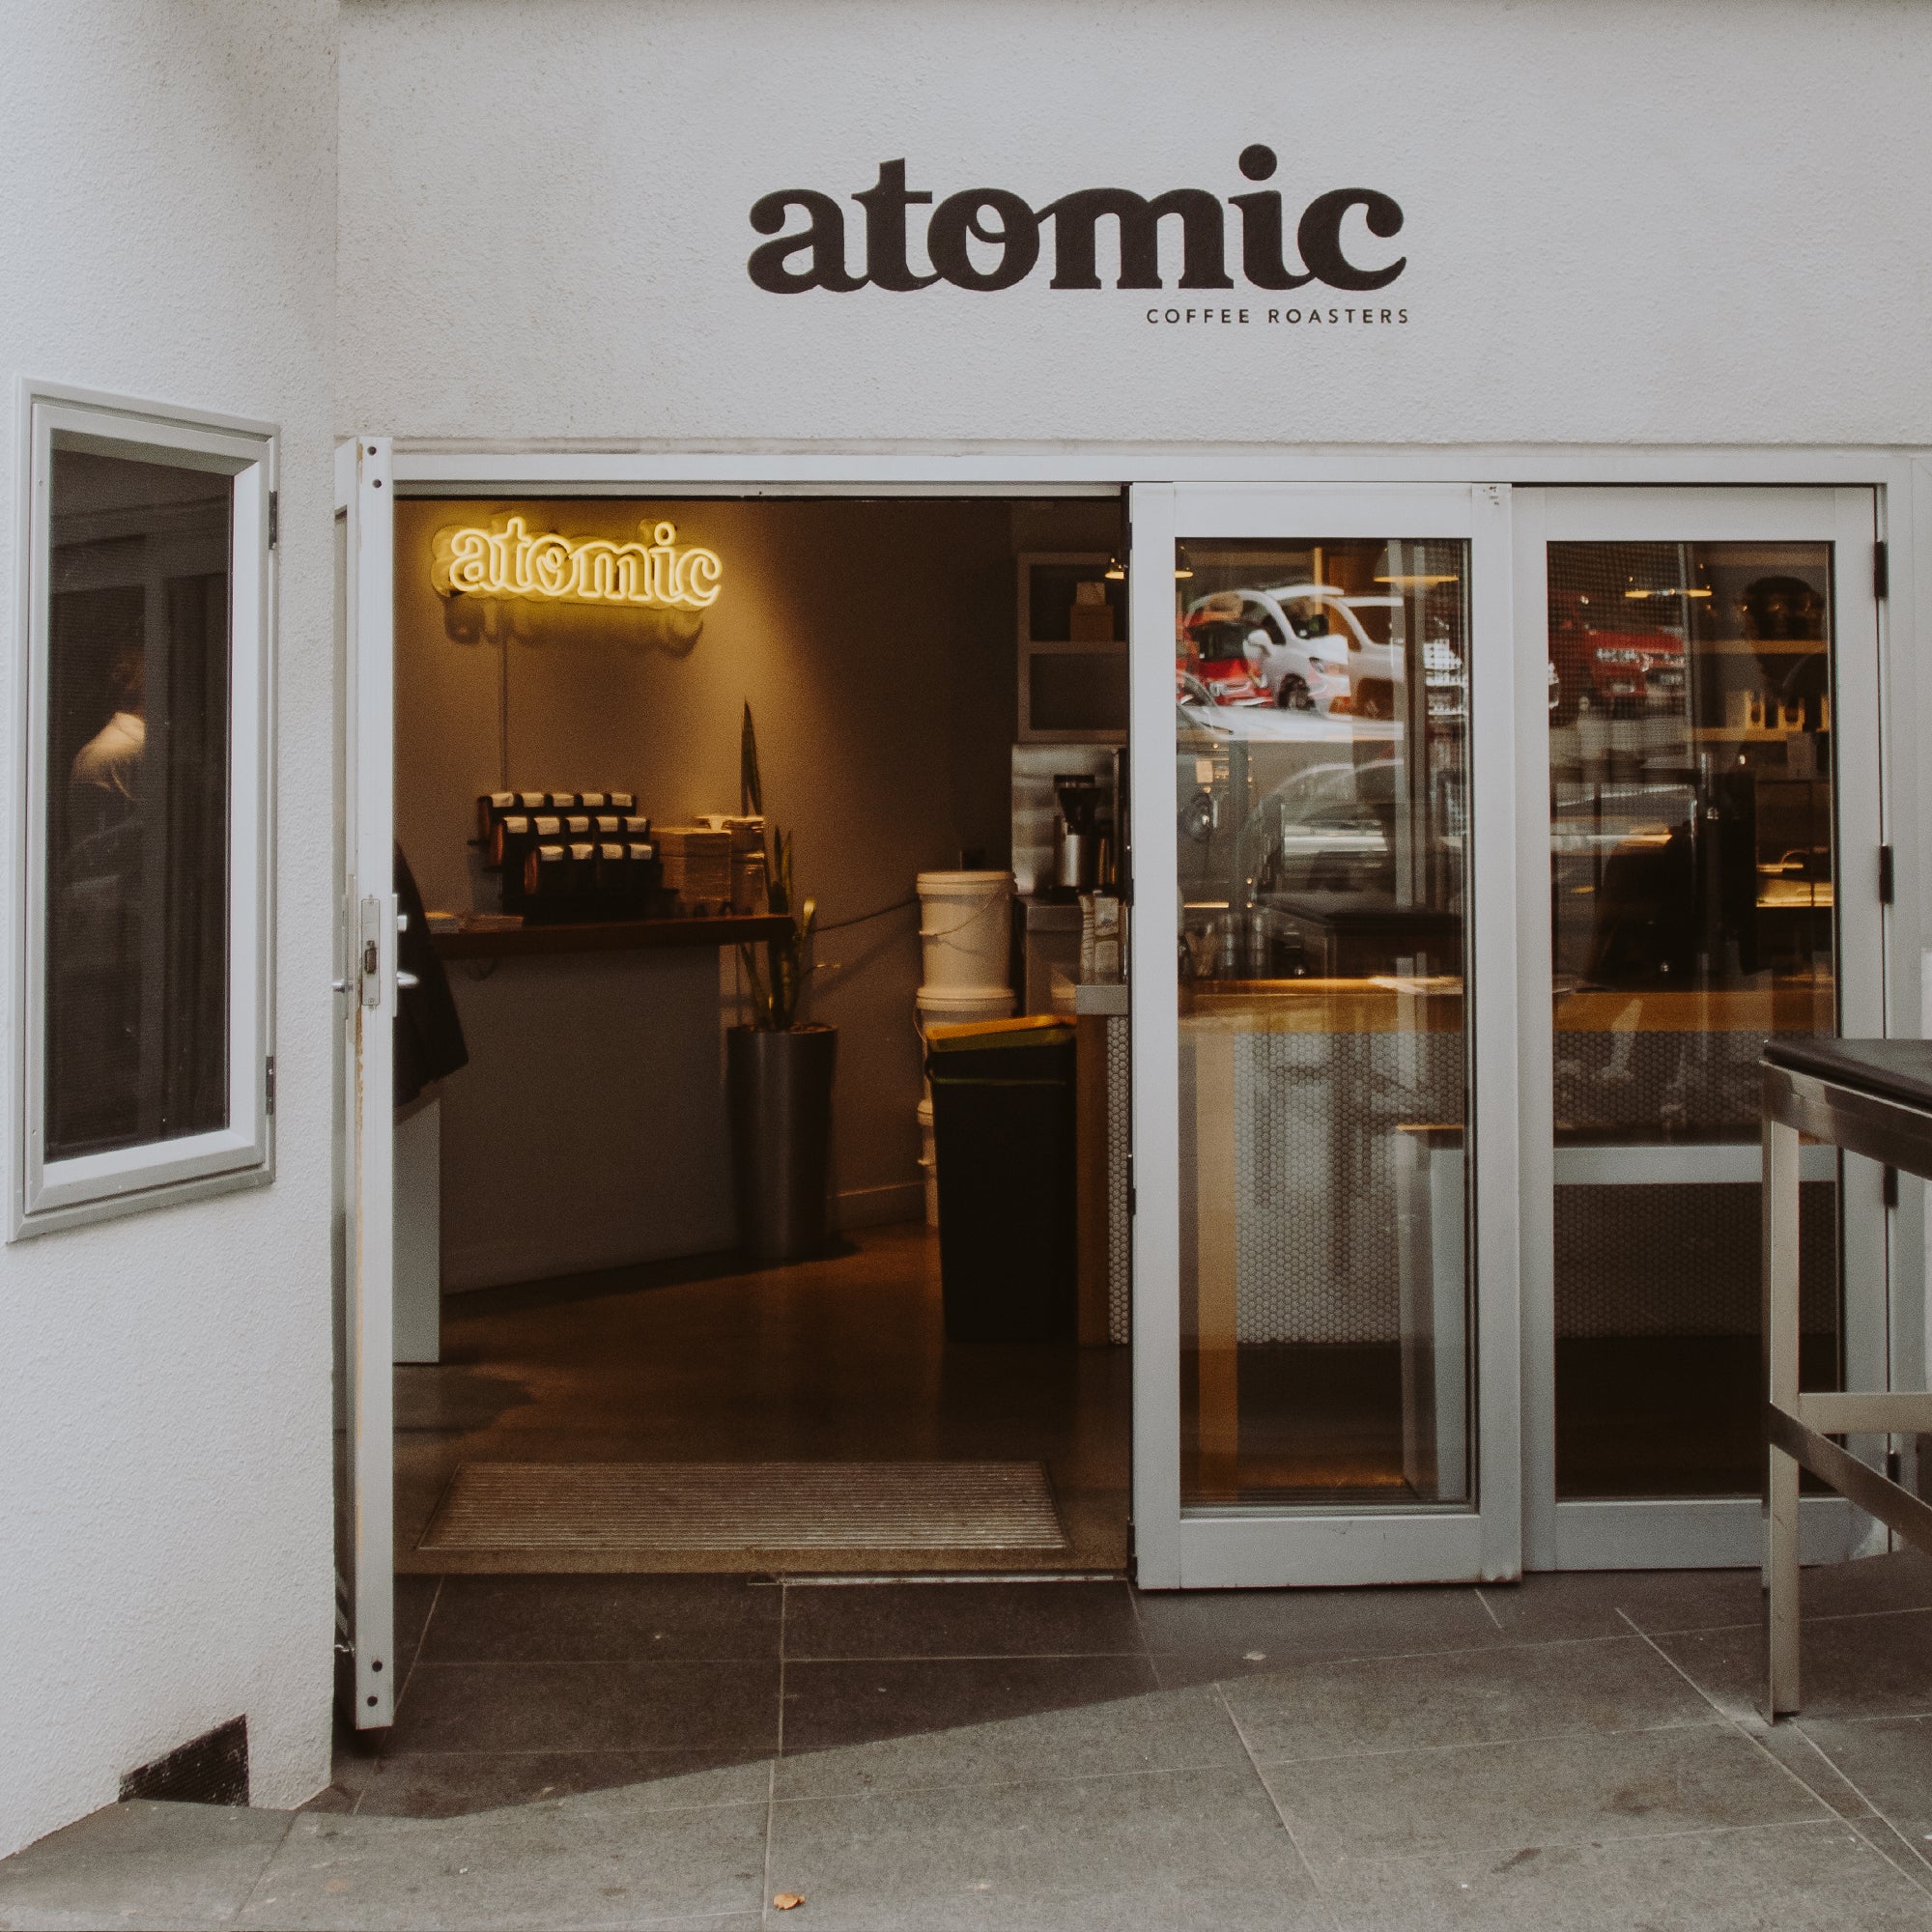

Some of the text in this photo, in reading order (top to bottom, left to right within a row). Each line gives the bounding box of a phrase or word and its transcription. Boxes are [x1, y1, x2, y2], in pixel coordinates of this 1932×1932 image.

[747, 143, 1407, 295] atomic
[1146, 308, 1409, 325] COFFEE ROASTERS
[449, 516, 724, 607] atomic
